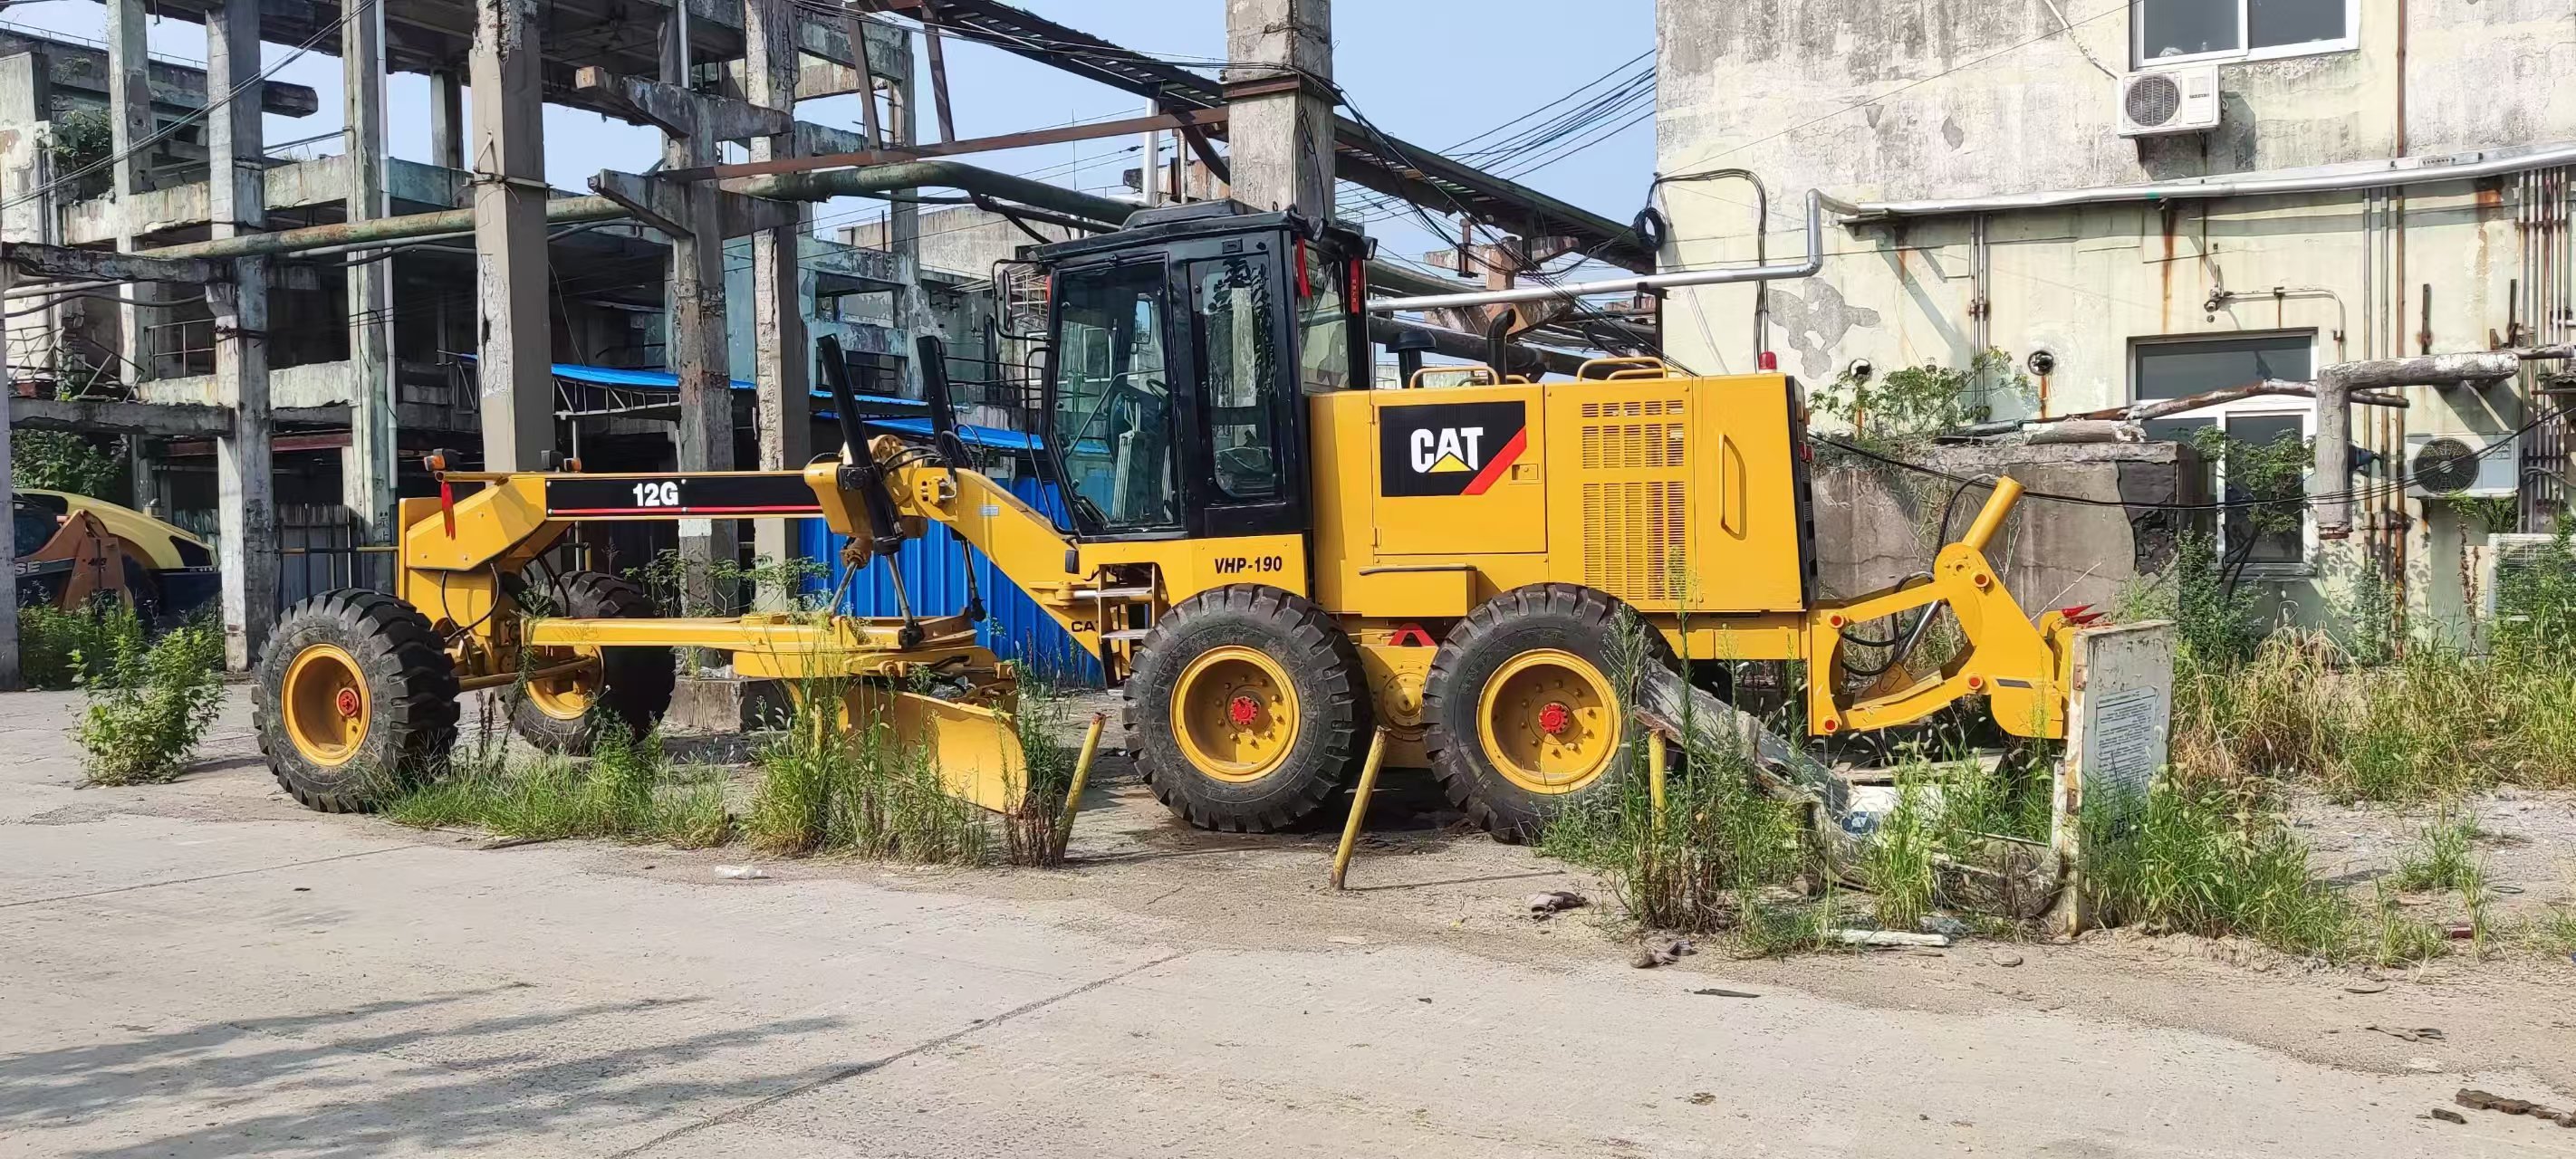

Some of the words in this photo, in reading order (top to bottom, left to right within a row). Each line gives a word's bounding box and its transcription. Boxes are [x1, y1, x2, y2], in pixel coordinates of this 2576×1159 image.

[1410, 426, 1484, 474] CAT
[632, 481, 679, 507] 12G
[1214, 555, 1283, 574] VHP-190
[1071, 620, 1099, 633] CA
